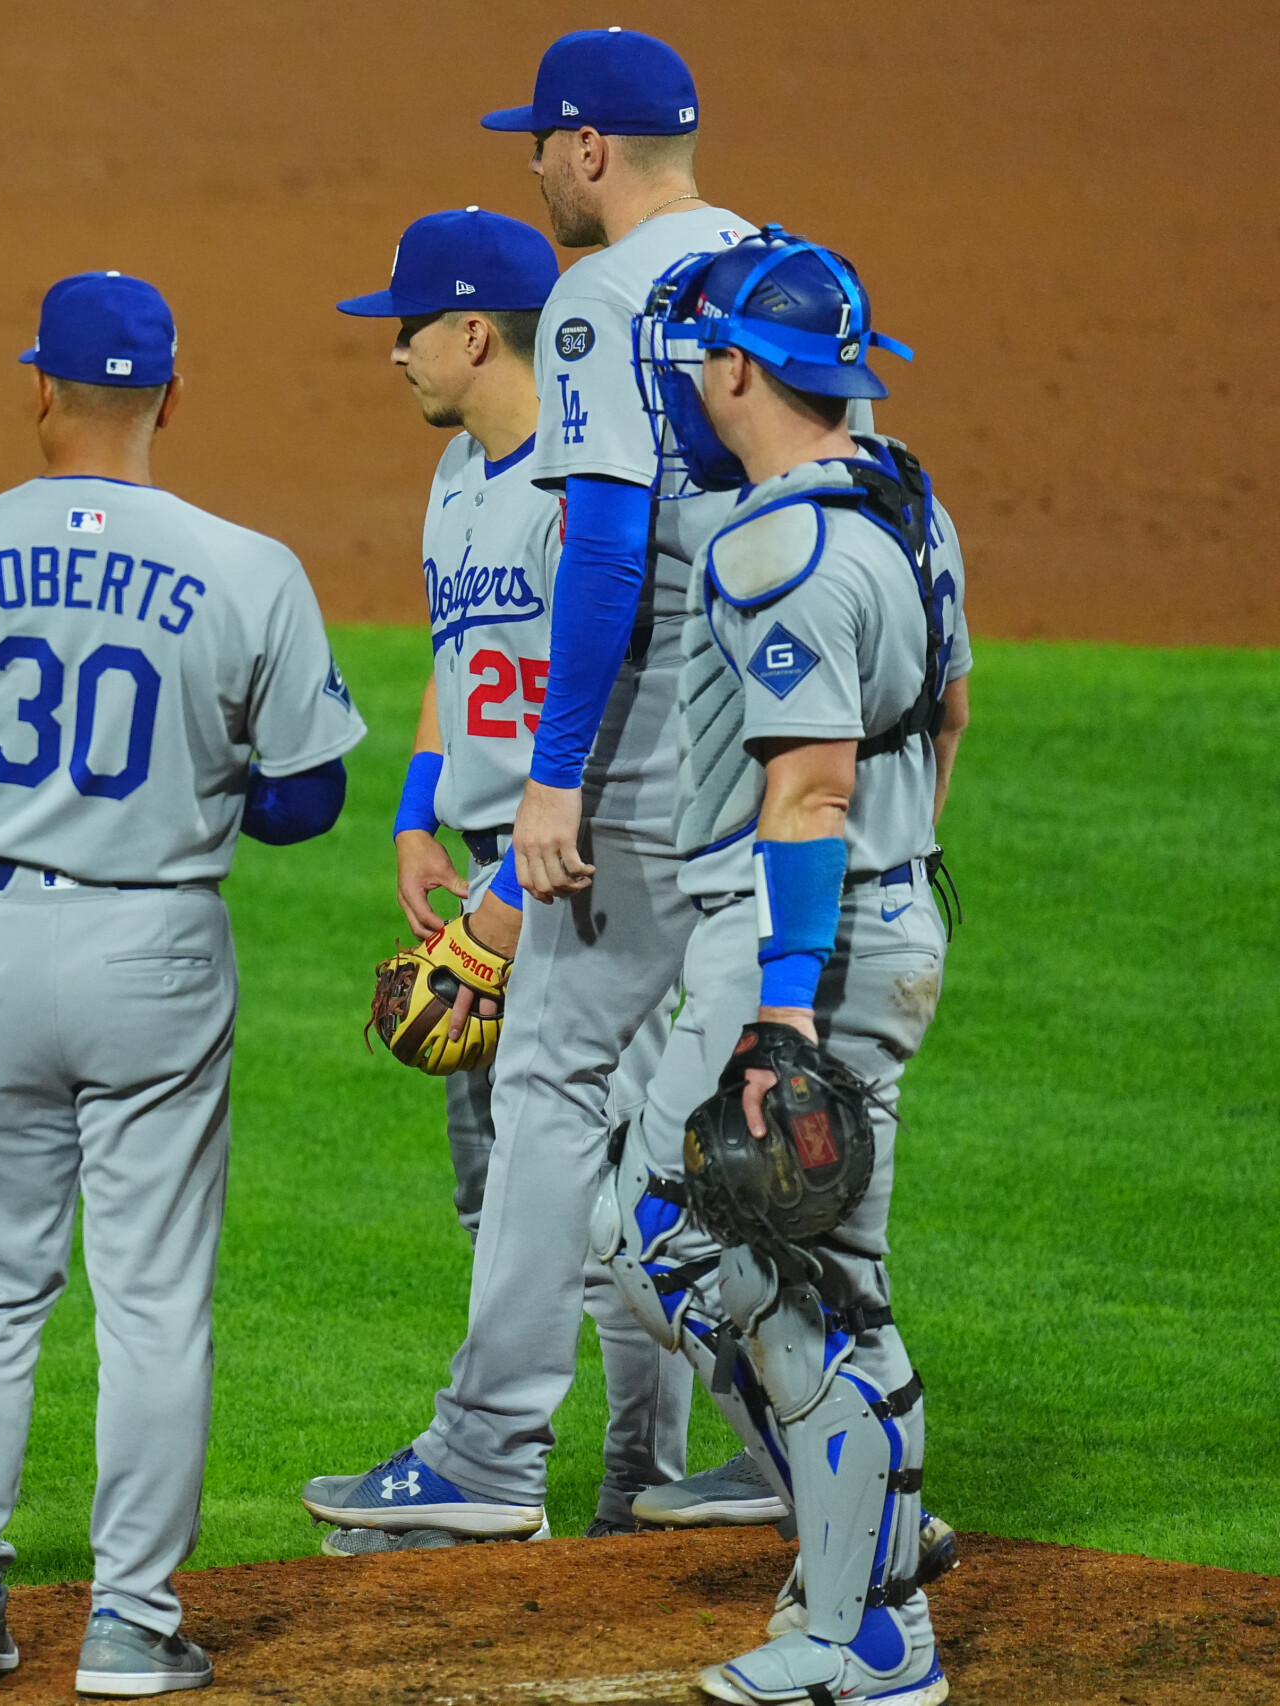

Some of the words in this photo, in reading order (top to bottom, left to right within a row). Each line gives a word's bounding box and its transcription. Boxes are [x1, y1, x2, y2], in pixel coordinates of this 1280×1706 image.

[561, 326, 588, 335] FERNANDO
[562, 333, 586, 354] 34
[557, 373, 588, 445] LA
[423, 544, 545, 657] Dodgers
[766, 643, 794, 669] G
[467, 649, 551, 739] 25
[448, 938, 495, 982] Wilson
